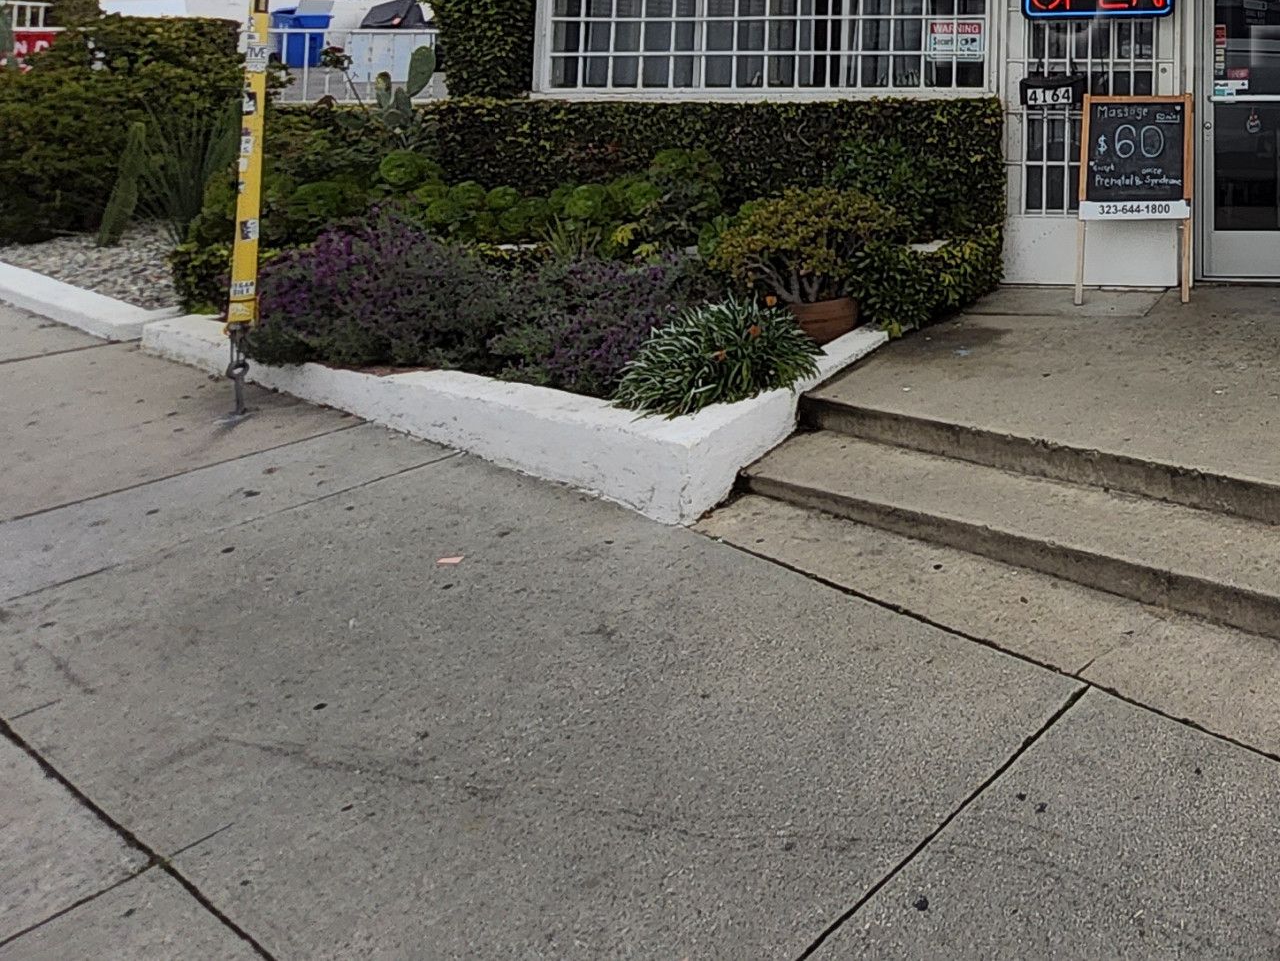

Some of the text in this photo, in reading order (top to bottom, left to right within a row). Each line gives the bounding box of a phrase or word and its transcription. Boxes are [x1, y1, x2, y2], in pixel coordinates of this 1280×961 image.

[1029, 88, 1071, 104] 4164
[1097, 105, 1149, 120] Massage
[1098, 203, 1171, 215] 323-644-1800
